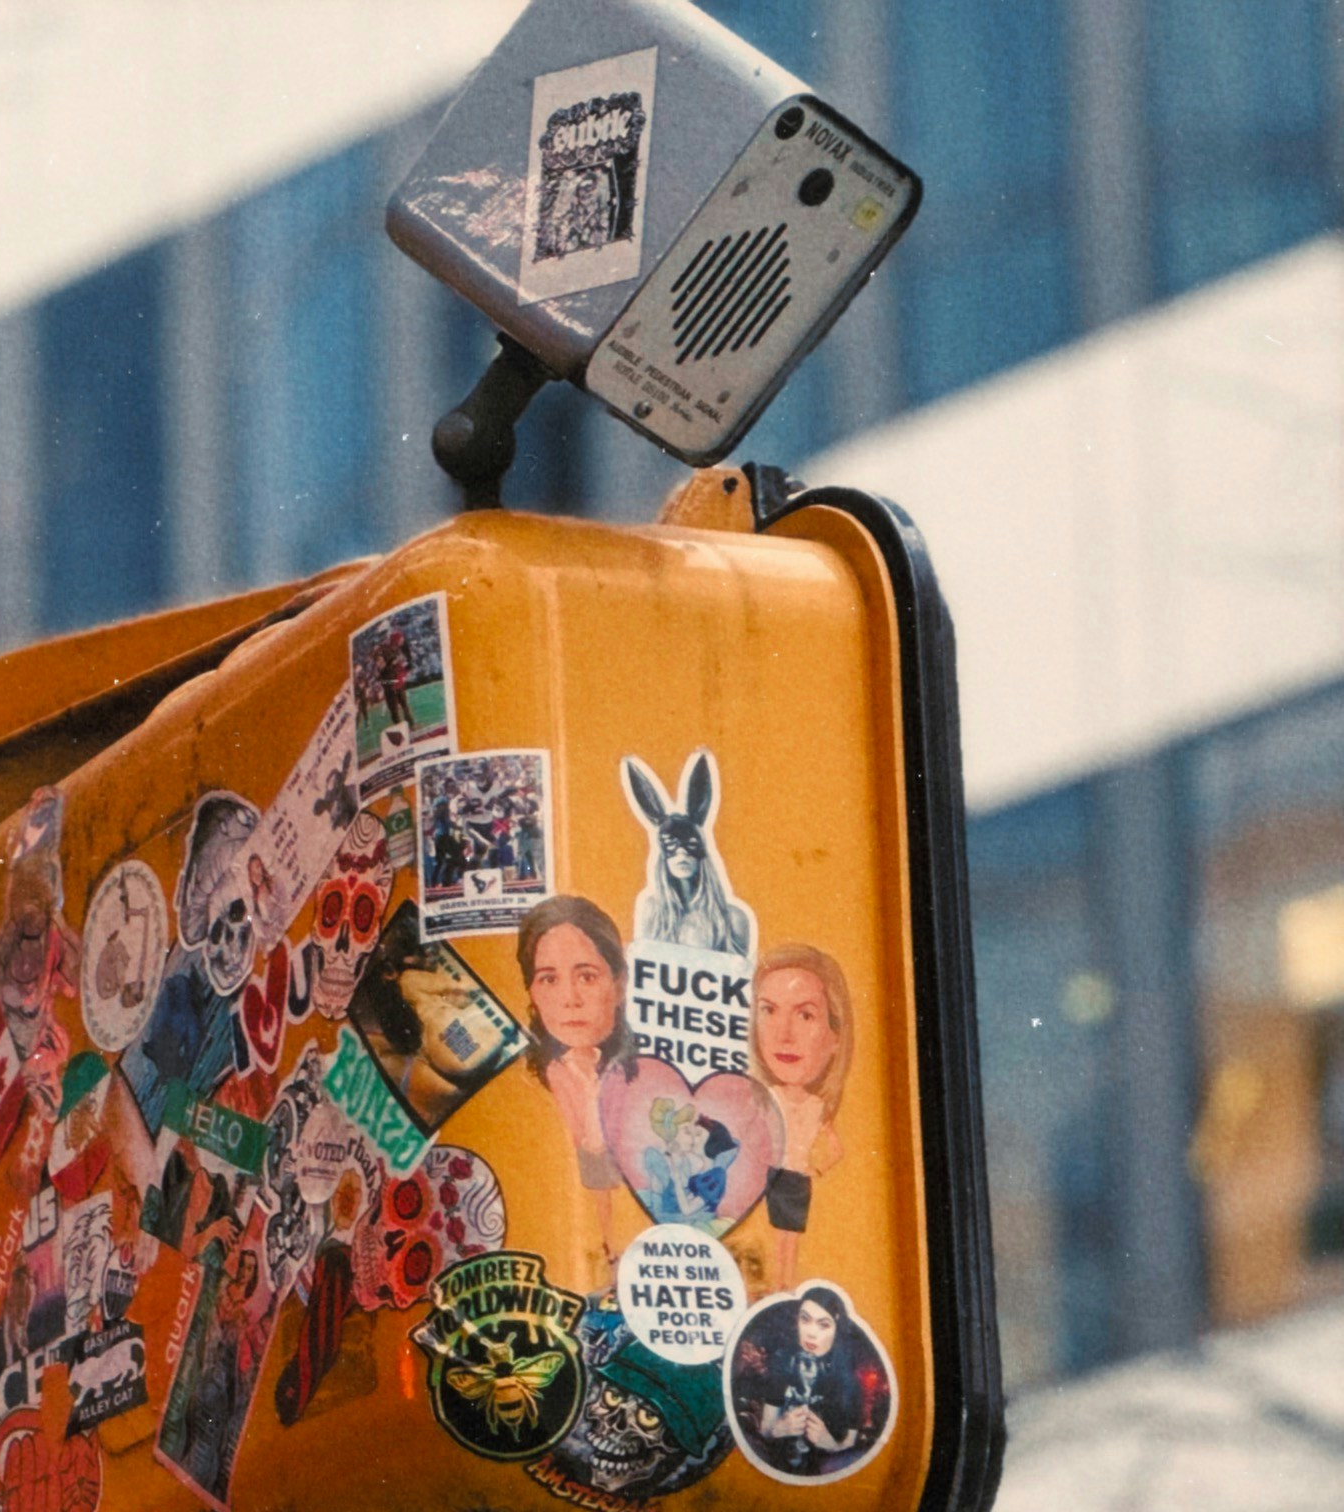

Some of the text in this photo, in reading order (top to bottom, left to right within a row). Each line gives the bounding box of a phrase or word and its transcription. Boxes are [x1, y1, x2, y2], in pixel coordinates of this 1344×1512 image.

[805, 121, 853, 163] NOVAX
[644, 365, 693, 401] PEDESTRIAN
[634, 961, 750, 1007] FUCK
[634, 997, 748, 1041] THESE
[634, 1033, 748, 1072] PRICES
[643, 1242, 711, 1258] MAYOR
[437, 1260, 539, 1298] ZOMBEEZ
[639, 1264, 720, 1281] KEN SIM
[166, 1267, 200, 1364] quark
[440, 1286, 577, 1334] WORLDWIDE
[630, 1284, 734, 1310] HATES
[650, 1330, 724, 1345] PEOPLE
[657, 1311, 711, 1327] POOR
[79, 1388, 134, 1421] ALLEY CAT
